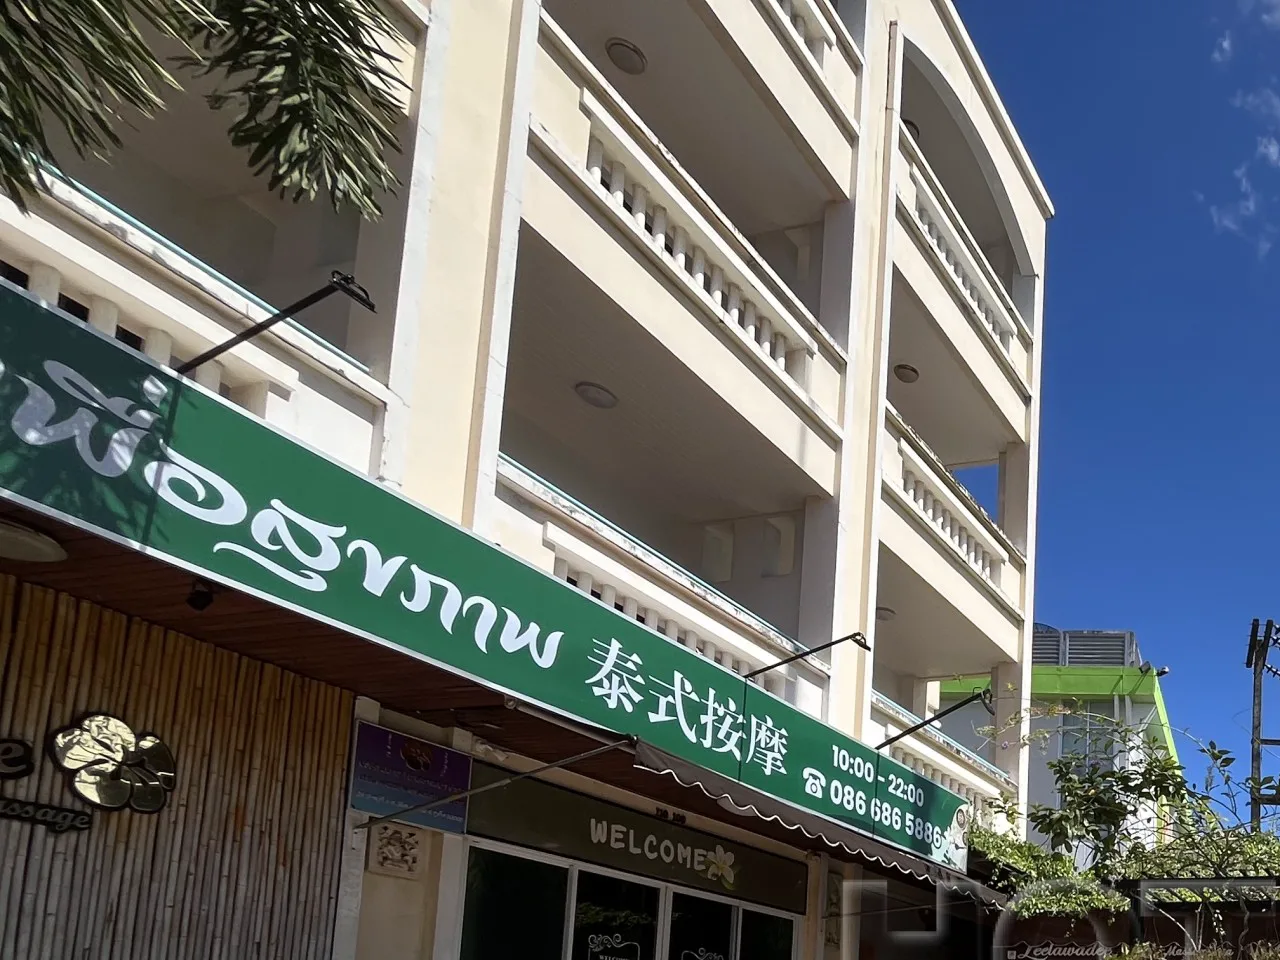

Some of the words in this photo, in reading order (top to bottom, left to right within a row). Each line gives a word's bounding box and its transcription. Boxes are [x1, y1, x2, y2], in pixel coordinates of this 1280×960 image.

[0, 359, 564, 669] พื่อสุขภาพ
[584, 637, 788, 776] 泰式按摩
[832, 744, 875, 783] 10:00
[887, 773, 924, 808] 22:00
[0, 801, 91, 831] ssage
[590, 818, 707, 871] WELCOME
[830, 779, 866, 816] 086
[870, 797, 902, 831] 686
[905, 811, 942, 850] 5886
